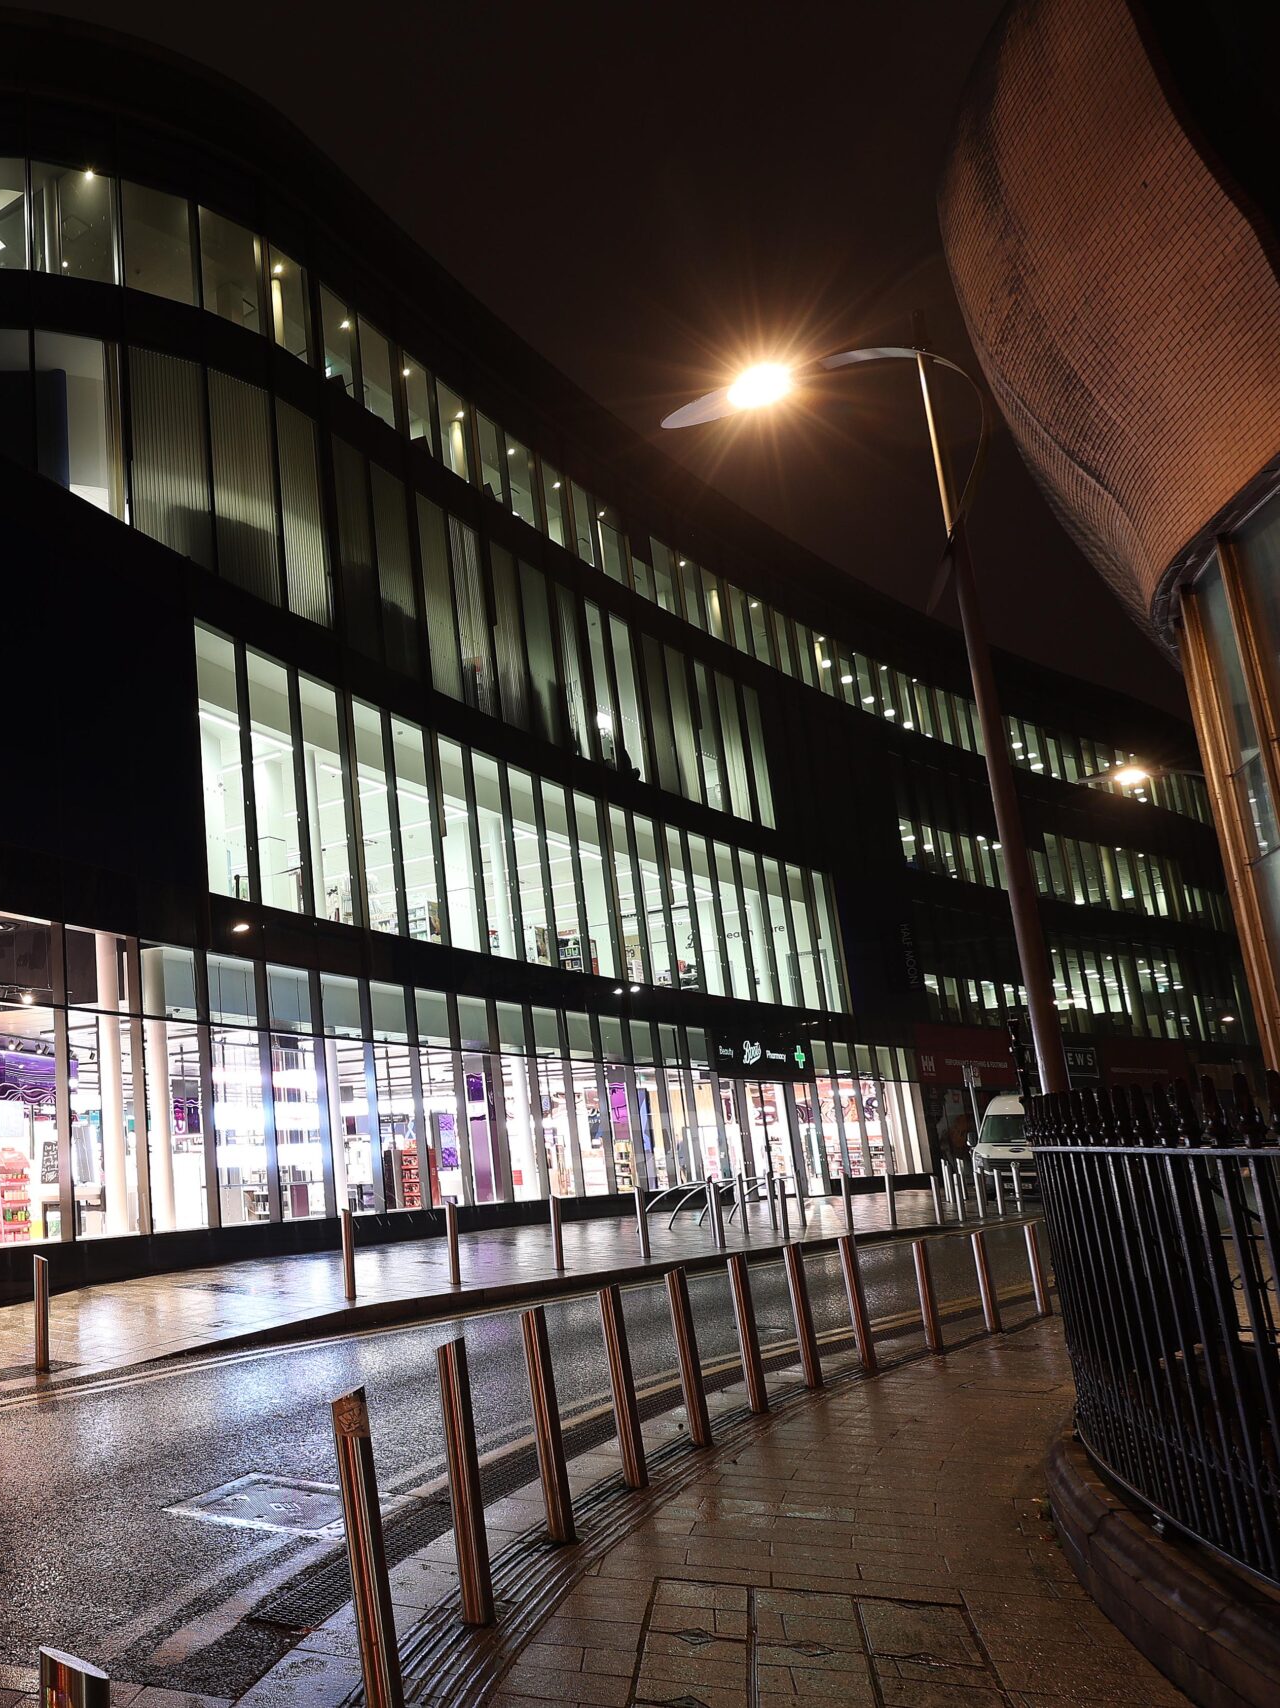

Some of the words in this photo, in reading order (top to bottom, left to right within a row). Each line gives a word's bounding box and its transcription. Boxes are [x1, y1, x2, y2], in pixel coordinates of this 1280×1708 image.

[904, 951, 919, 984] MOON
[718, 1045, 734, 1058] Beauty
[742, 1040, 762, 1065] Boots
[766, 1049, 786, 1063] Pharmacy
[1024, 1050, 1094, 1066] MEWS
[921, 1055, 935, 1072] HH
